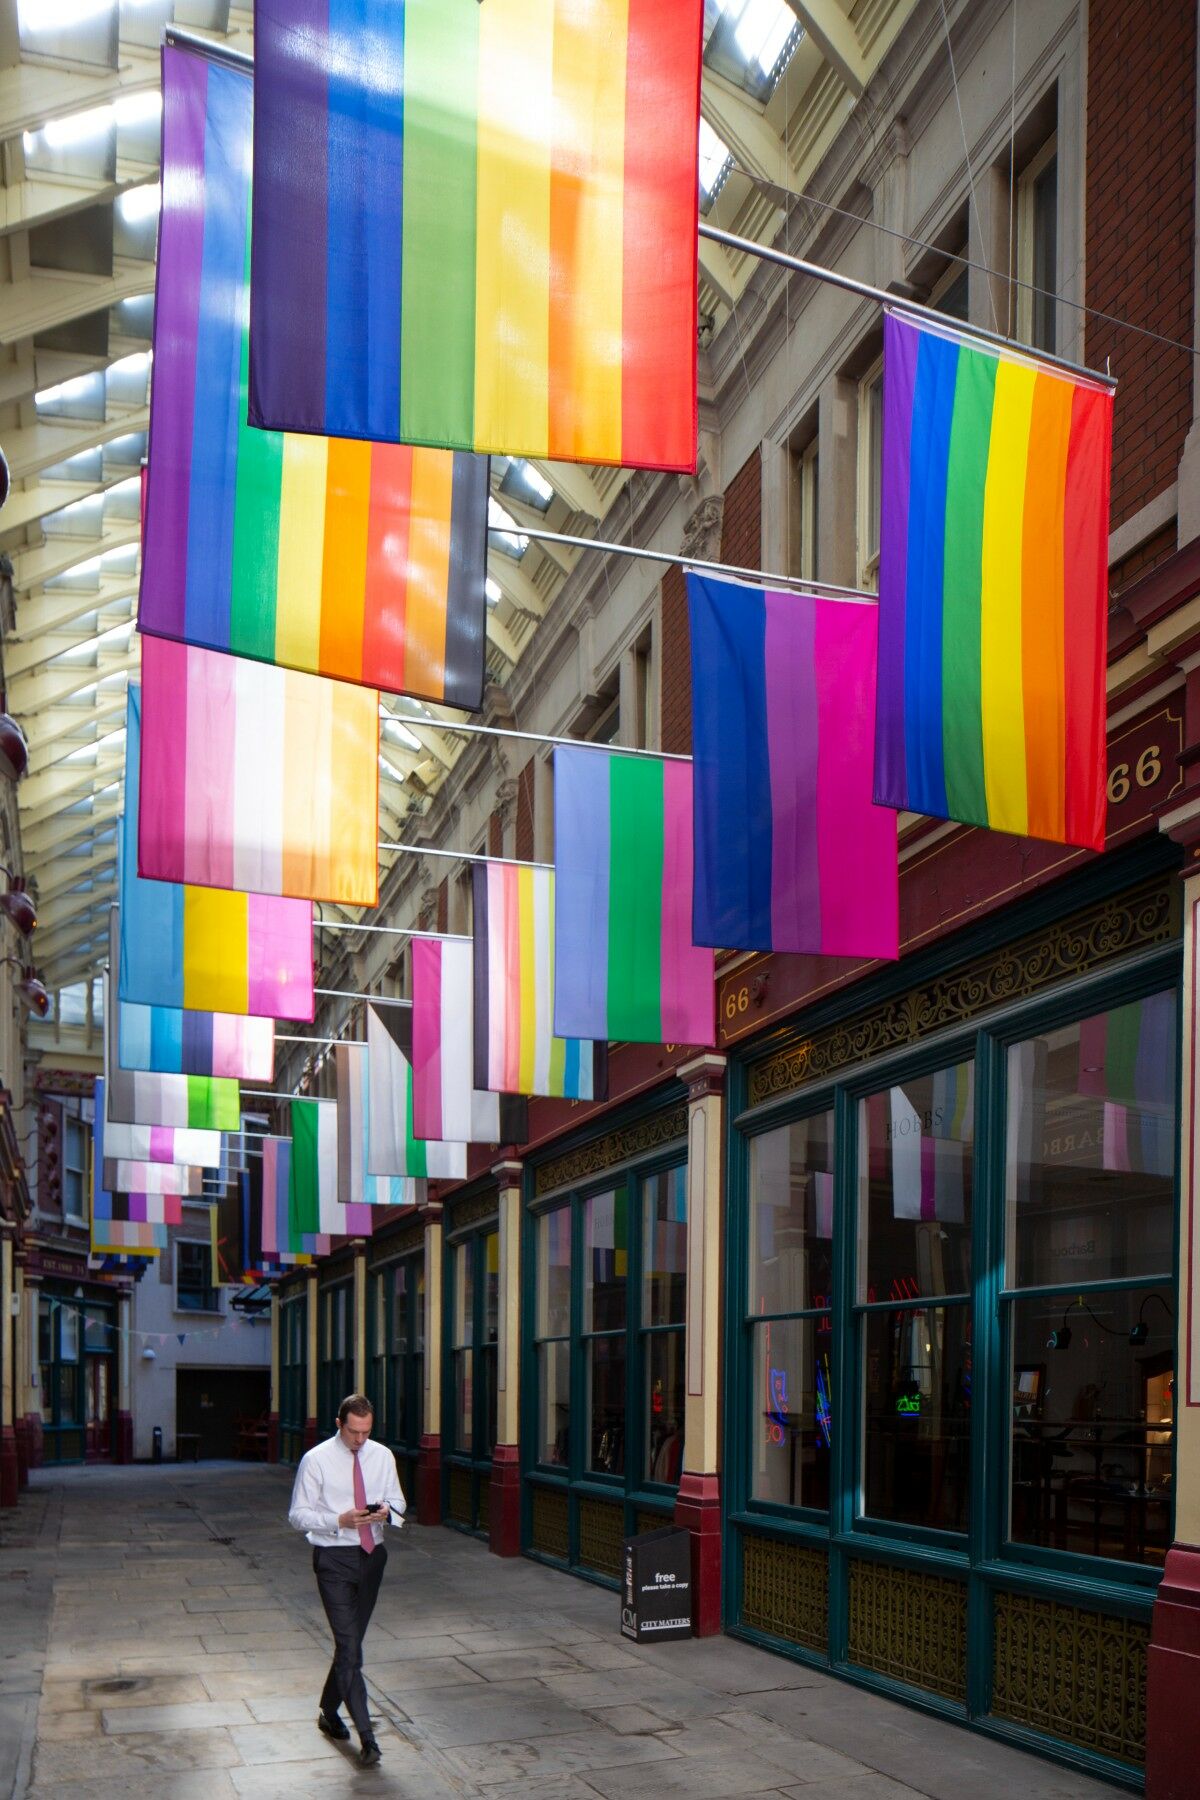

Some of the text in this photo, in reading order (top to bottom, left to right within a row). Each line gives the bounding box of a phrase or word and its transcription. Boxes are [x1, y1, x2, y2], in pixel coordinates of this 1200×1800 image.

[1106, 745, 1161, 803] 66
[726, 987, 749, 1019] 66
[655, 1572, 676, 1583] free
[641, 1617, 691, 1628] CITY MATTERS
